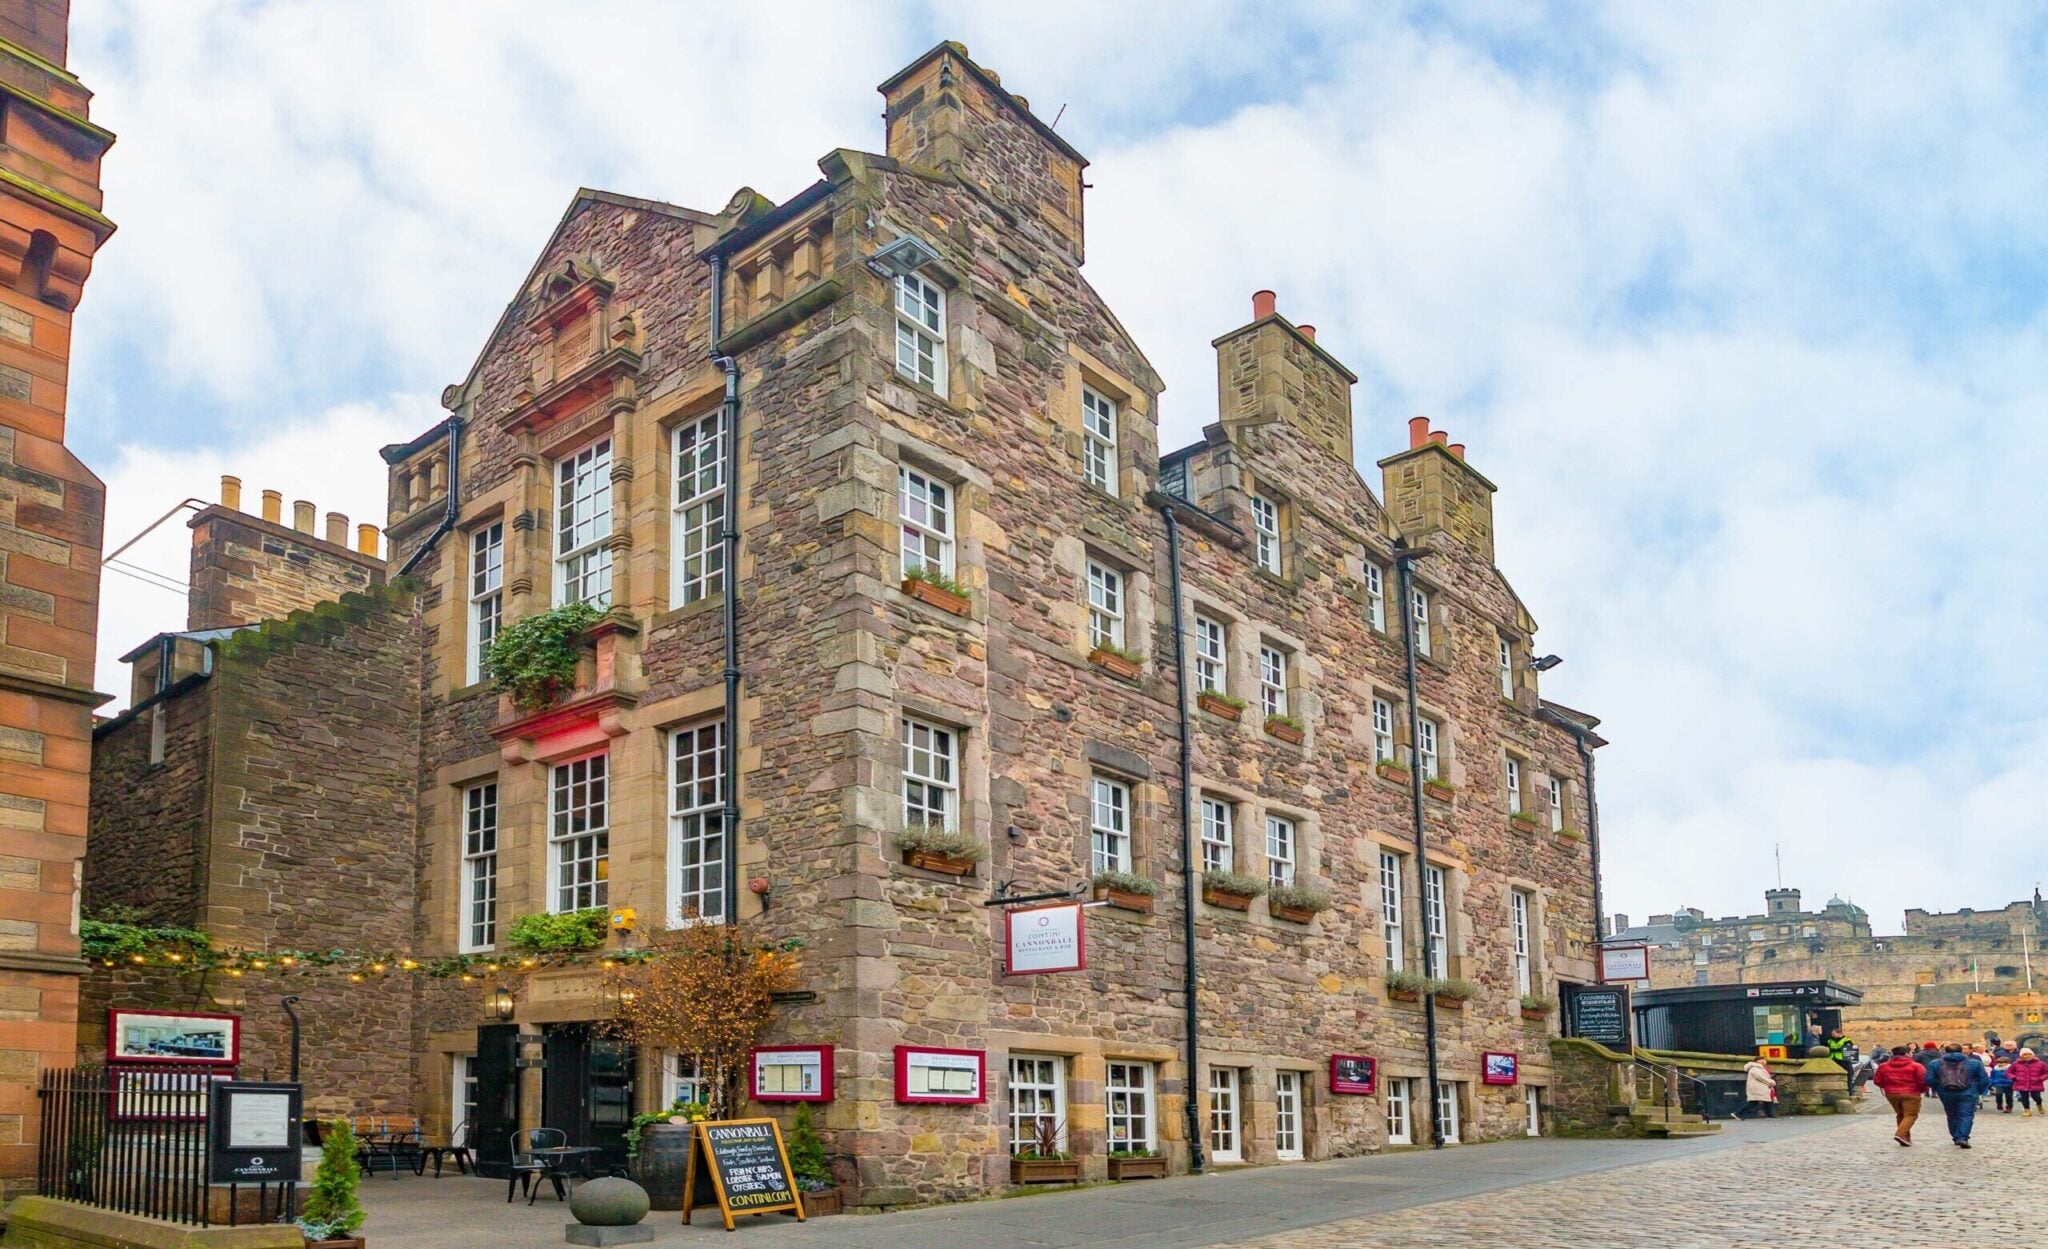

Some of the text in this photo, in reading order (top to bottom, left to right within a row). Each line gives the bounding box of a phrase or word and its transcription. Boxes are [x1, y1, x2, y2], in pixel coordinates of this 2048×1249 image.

[1028, 931, 1061, 940] CONTINI
[1015, 937, 1074, 948] CANNONBALL
[709, 1126, 772, 1140] CANNONBALL
[726, 1171, 782, 1185] LOBSTER SALMON
[729, 1168, 745, 1177] FISH
[732, 1181, 766, 1192] OYSTERS
[728, 1190, 792, 1207] CONTINI.COM
